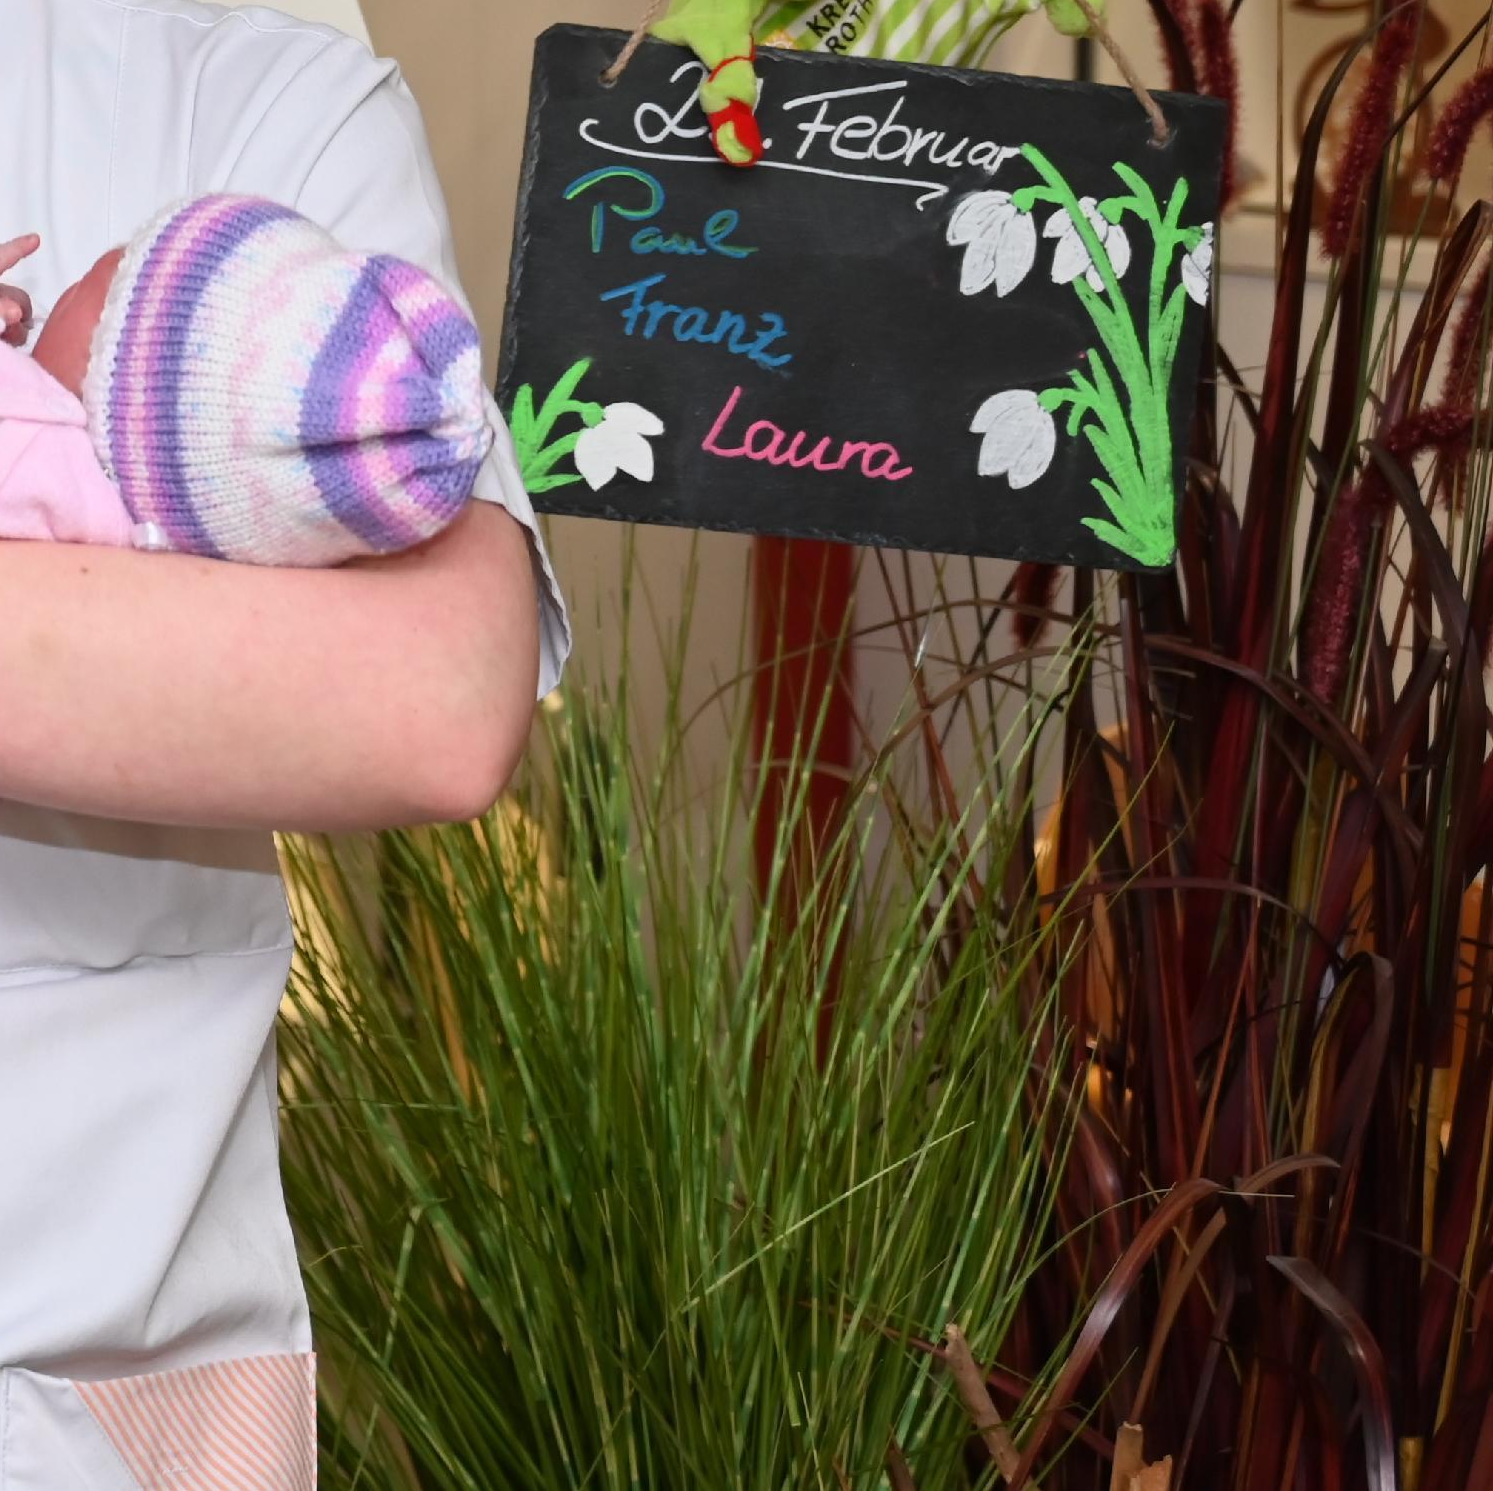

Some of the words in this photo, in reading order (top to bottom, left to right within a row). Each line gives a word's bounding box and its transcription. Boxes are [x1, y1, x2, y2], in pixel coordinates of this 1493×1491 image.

[633, 60, 773, 150] 2.
[783, 80, 1023, 176] Februar
[563, 165, 759, 259] Paul
[599, 272, 794, 368] Franz
[701, 385, 914, 481] Laura
